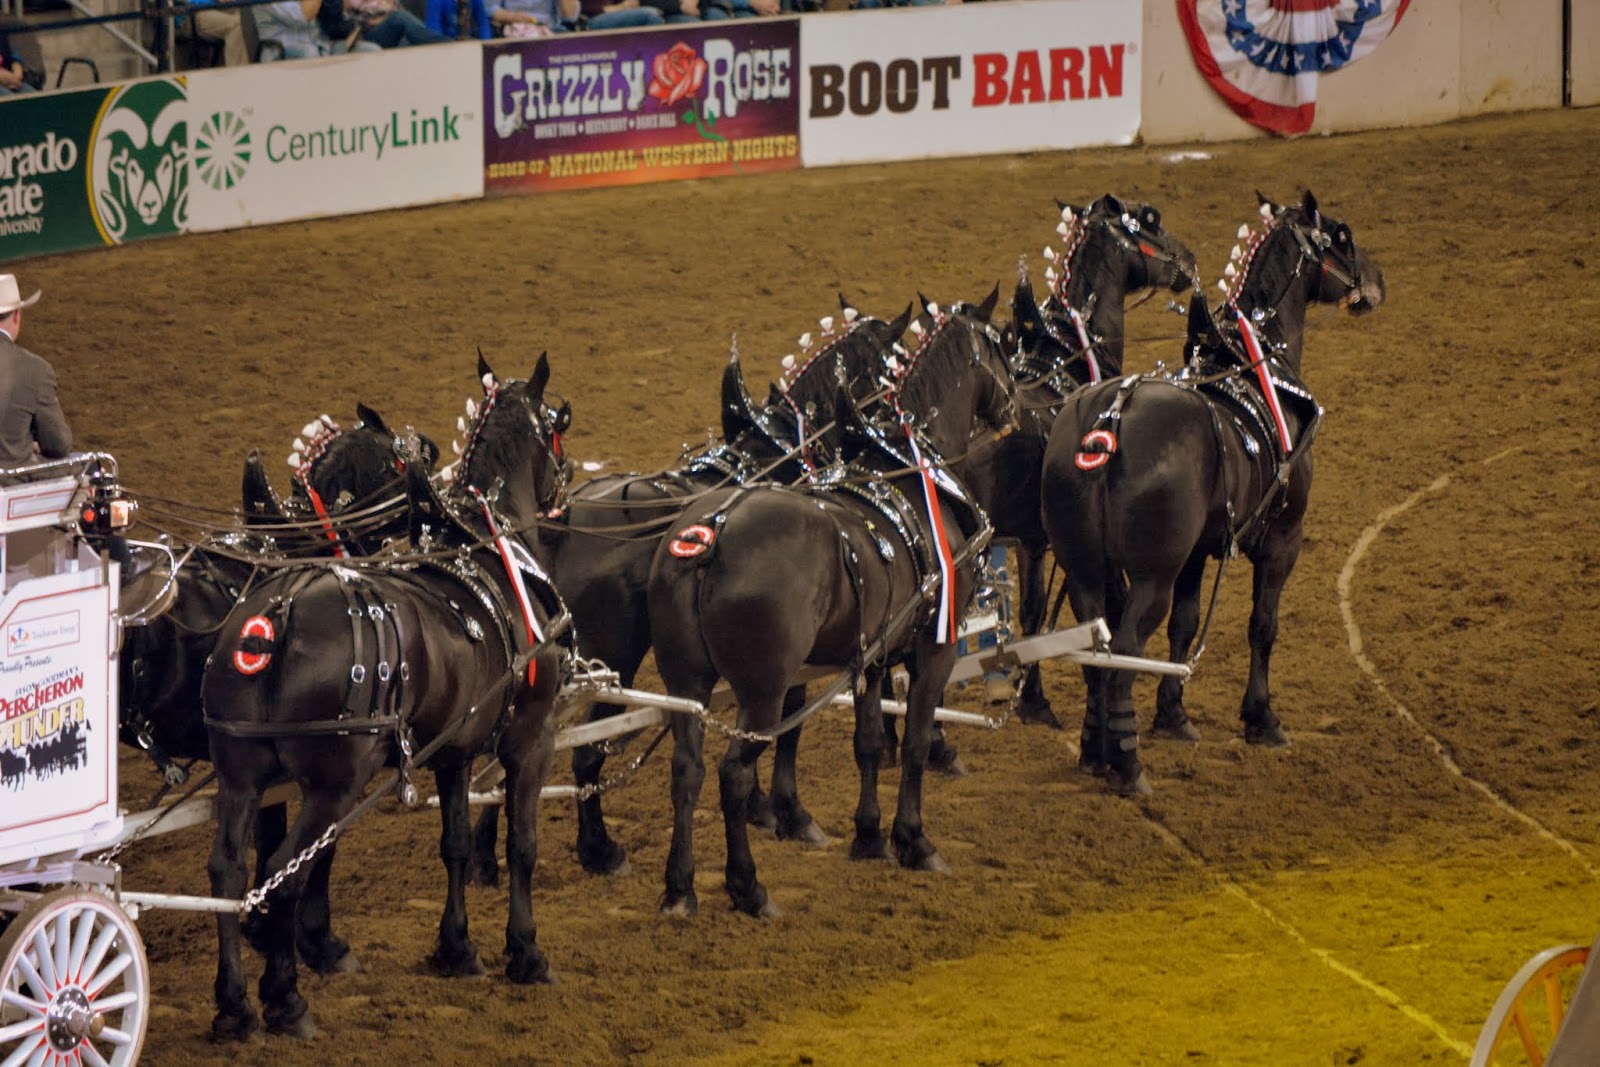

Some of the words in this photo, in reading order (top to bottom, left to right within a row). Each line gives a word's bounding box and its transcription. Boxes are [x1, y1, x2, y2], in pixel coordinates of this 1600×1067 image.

[493, 53, 645, 139] GRIZZLY
[703, 39, 791, 119] ROSE
[809, 56, 962, 119] BOOT
[972, 43, 1126, 108] BARN
[266, 105, 460, 163] CenturyLink
[549, 149, 637, 178] NATIONAL
[643, 140, 729, 167] WESTERN
[732, 134, 797, 162] NIGHTS
